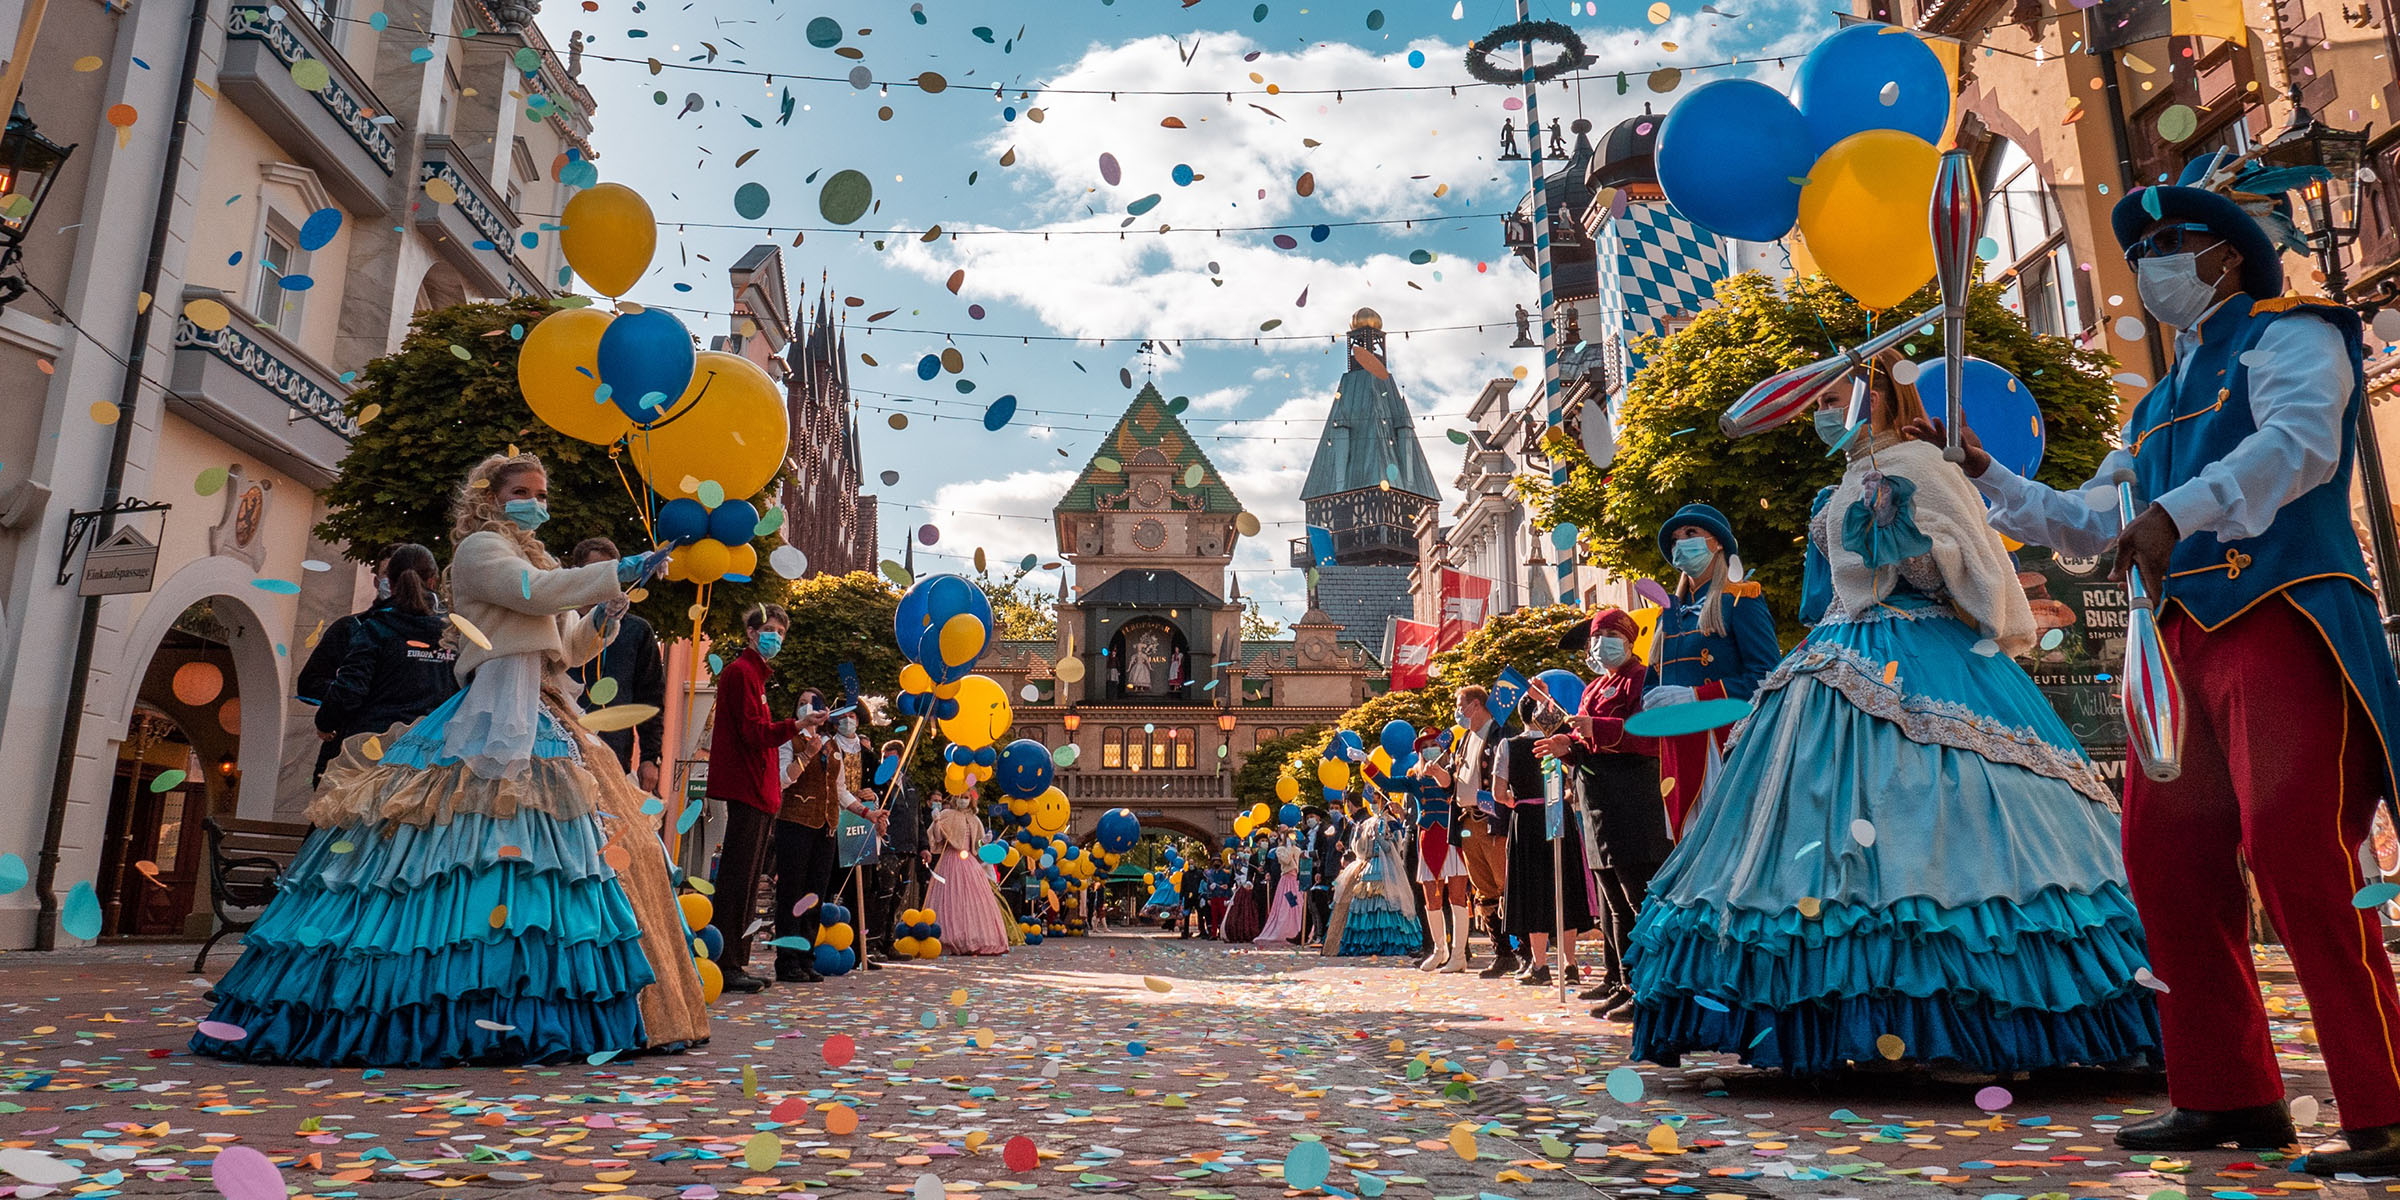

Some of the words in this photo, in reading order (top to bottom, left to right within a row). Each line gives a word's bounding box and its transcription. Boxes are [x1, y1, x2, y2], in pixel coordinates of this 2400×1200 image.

[86, 567, 150, 580] Einkaufspassage
[2082, 590, 2128, 607] ROCK
[2088, 631, 2125, 639] SIMPLY
[407, 650, 434, 658] EUROPA
[2029, 674, 2066, 685] EUTE
[2072, 674, 2101, 685] LIVE
[846, 825, 868, 836] ZEIT.
